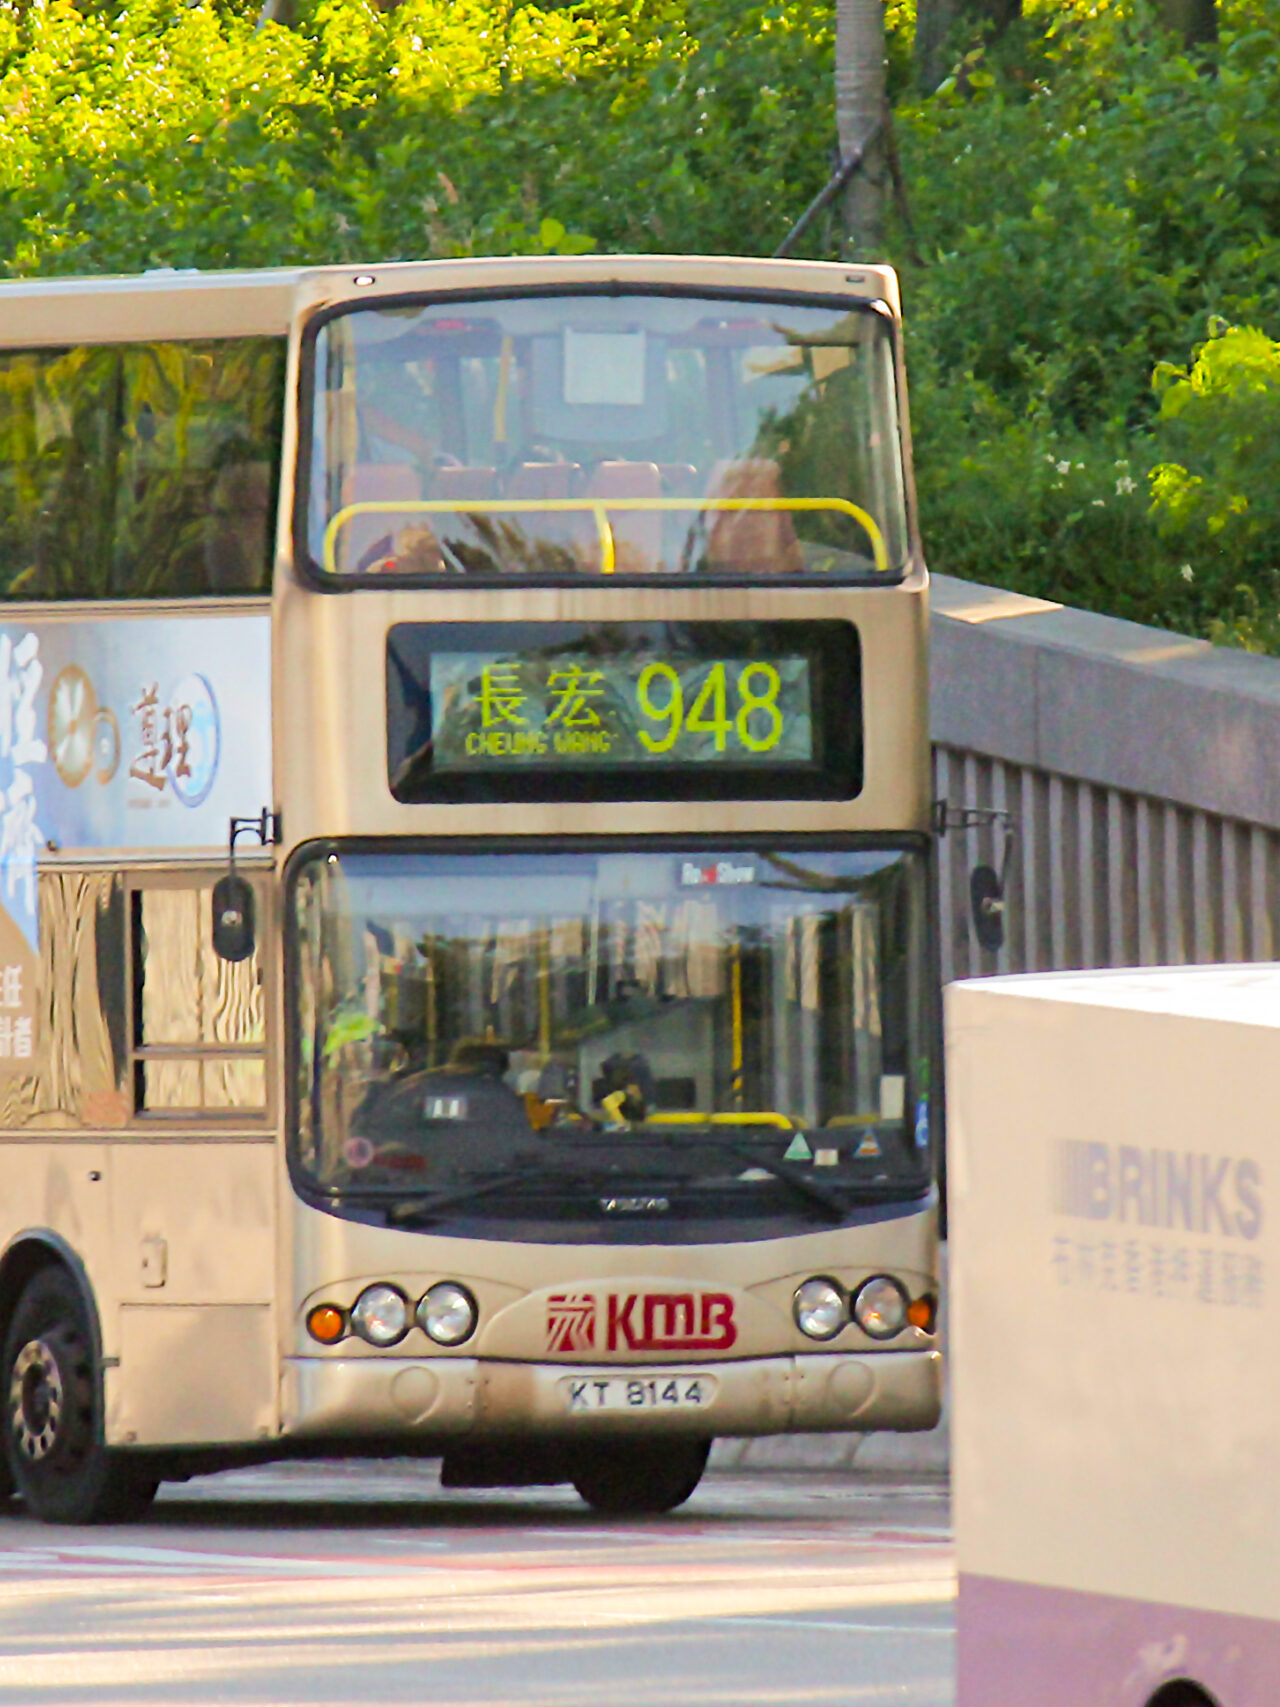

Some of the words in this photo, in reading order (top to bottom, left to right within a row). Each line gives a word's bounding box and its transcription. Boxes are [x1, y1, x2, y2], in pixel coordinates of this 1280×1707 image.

[472, 664, 606, 727] 長宏
[636, 662, 783, 753] 948
[465, 732, 547, 755] CHEUNG
[608, 1292, 737, 1351] KMB
[570, 1381, 609, 1407] KT
[627, 1380, 701, 1405] 8144
